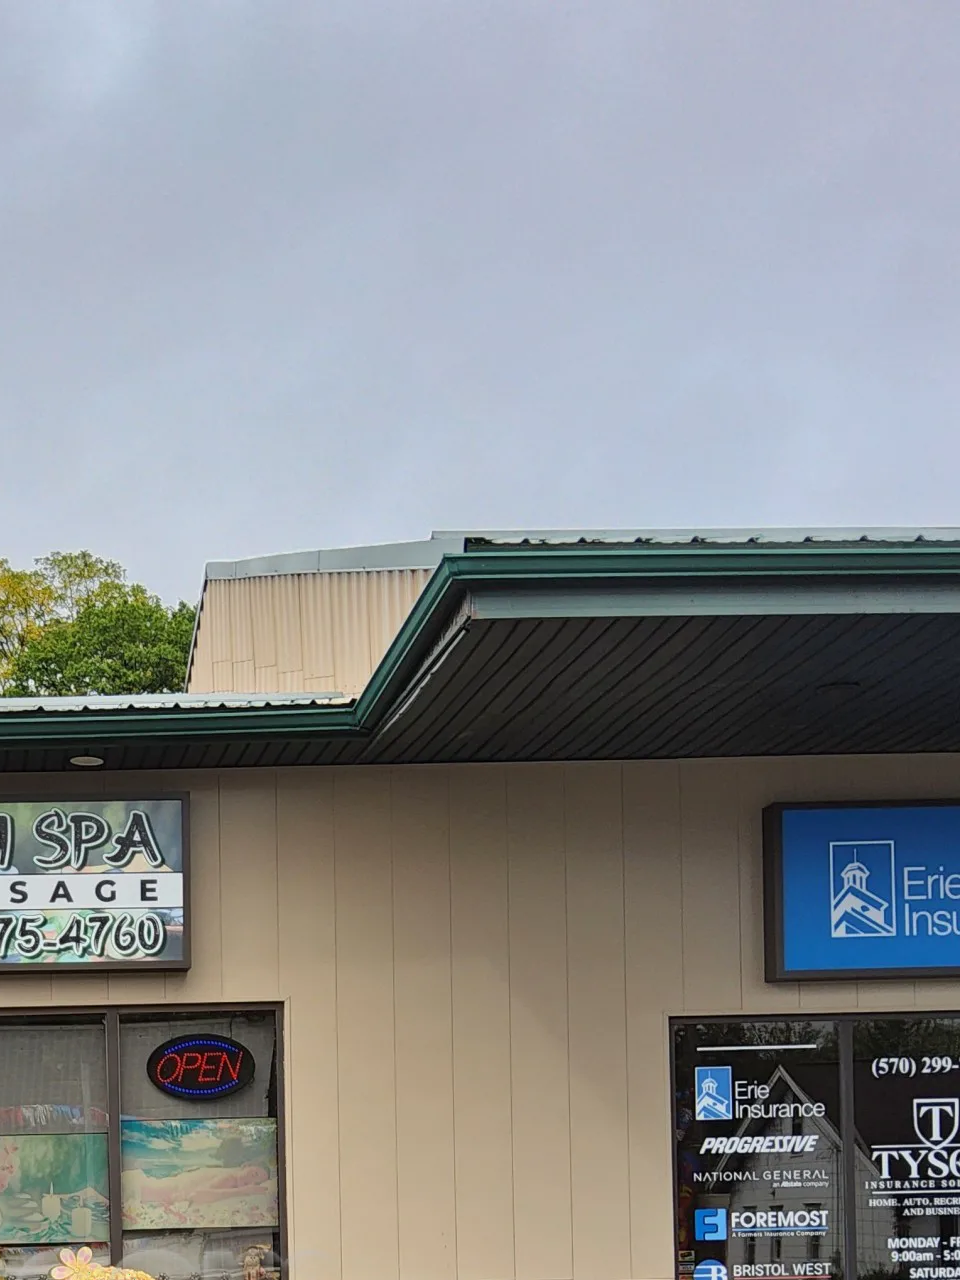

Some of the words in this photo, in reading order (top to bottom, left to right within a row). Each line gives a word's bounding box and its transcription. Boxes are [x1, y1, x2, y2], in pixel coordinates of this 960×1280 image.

[33, 808, 164, 870] SPA
[157, 1051, 243, 1083] OPEN
[871, 1057, 917, 1079] (570)
[921, 1056, 960, 1074] 299-
[734, 1080, 770, 1100] Erie
[734, 1100, 826, 1119] Insurance
[699, 1135, 819, 1155] PROGRESSIVE
[693, 1171, 760, 1182] NATIONAL
[762, 1169, 829, 1180] GENERAL
[803, 1180, 829, 1189] company
[864, 1180, 936, 1190] INSURANCE
[731, 1210, 829, 1228] FOREMOST
[902, 1207, 924, 1216] AND
[887, 1236, 941, 1249] MONDAY
[891, 1250, 934, 1262] 9:00am
[733, 1264, 789, 1277] BRISTOL
[793, 1263, 832, 1275] WEST
